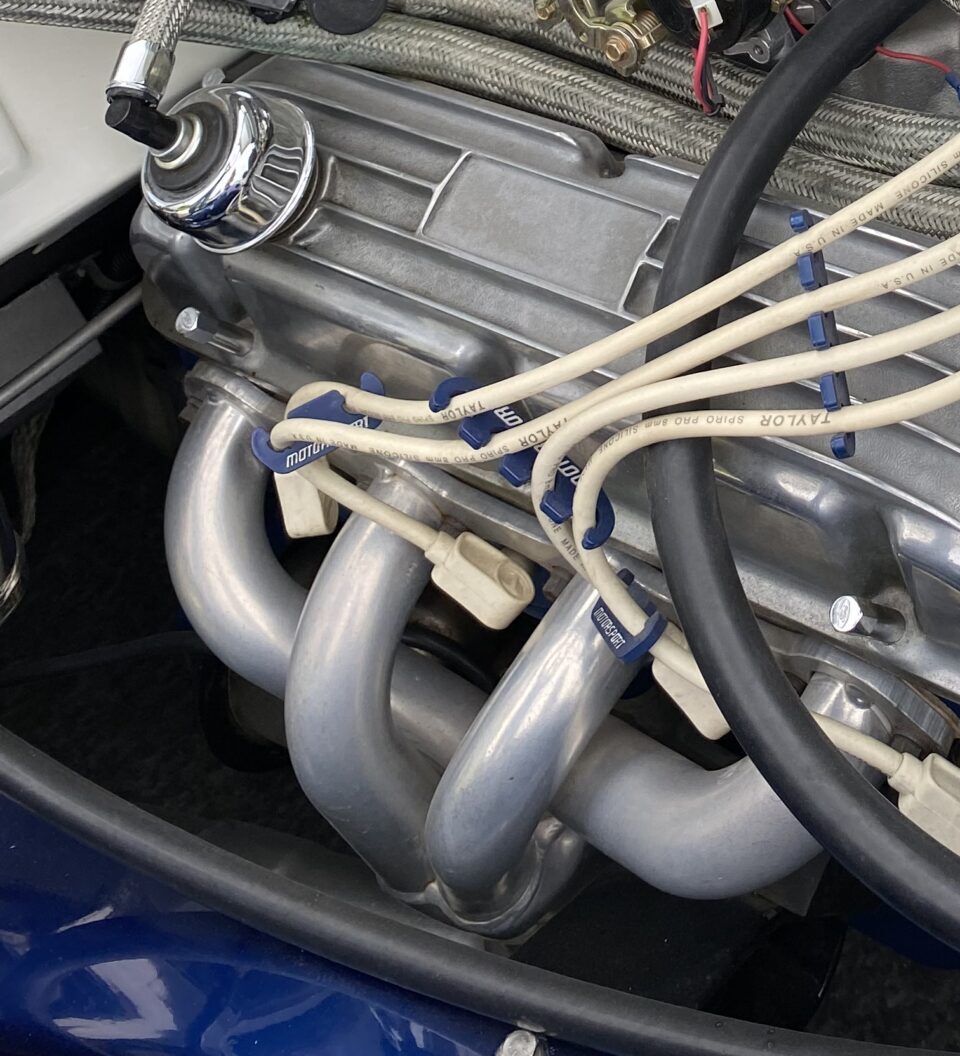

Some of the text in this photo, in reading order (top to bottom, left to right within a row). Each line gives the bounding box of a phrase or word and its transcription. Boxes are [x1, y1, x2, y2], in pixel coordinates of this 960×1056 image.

[897, 160, 949, 200] SILICONE
[851, 202, 885, 227] MADE
[832, 227, 845, 238] IN
[921, 264, 934, 275] IN
[441, 400, 487, 420] TAYLOR
[600, 413, 831, 454] TAYLOR SPIRO PRO 8mm SILICONE
[480, 445, 510, 459] SPIRO
[561, 538, 580, 561] MADE
[593, 607, 626, 650] MOTORSPORT
